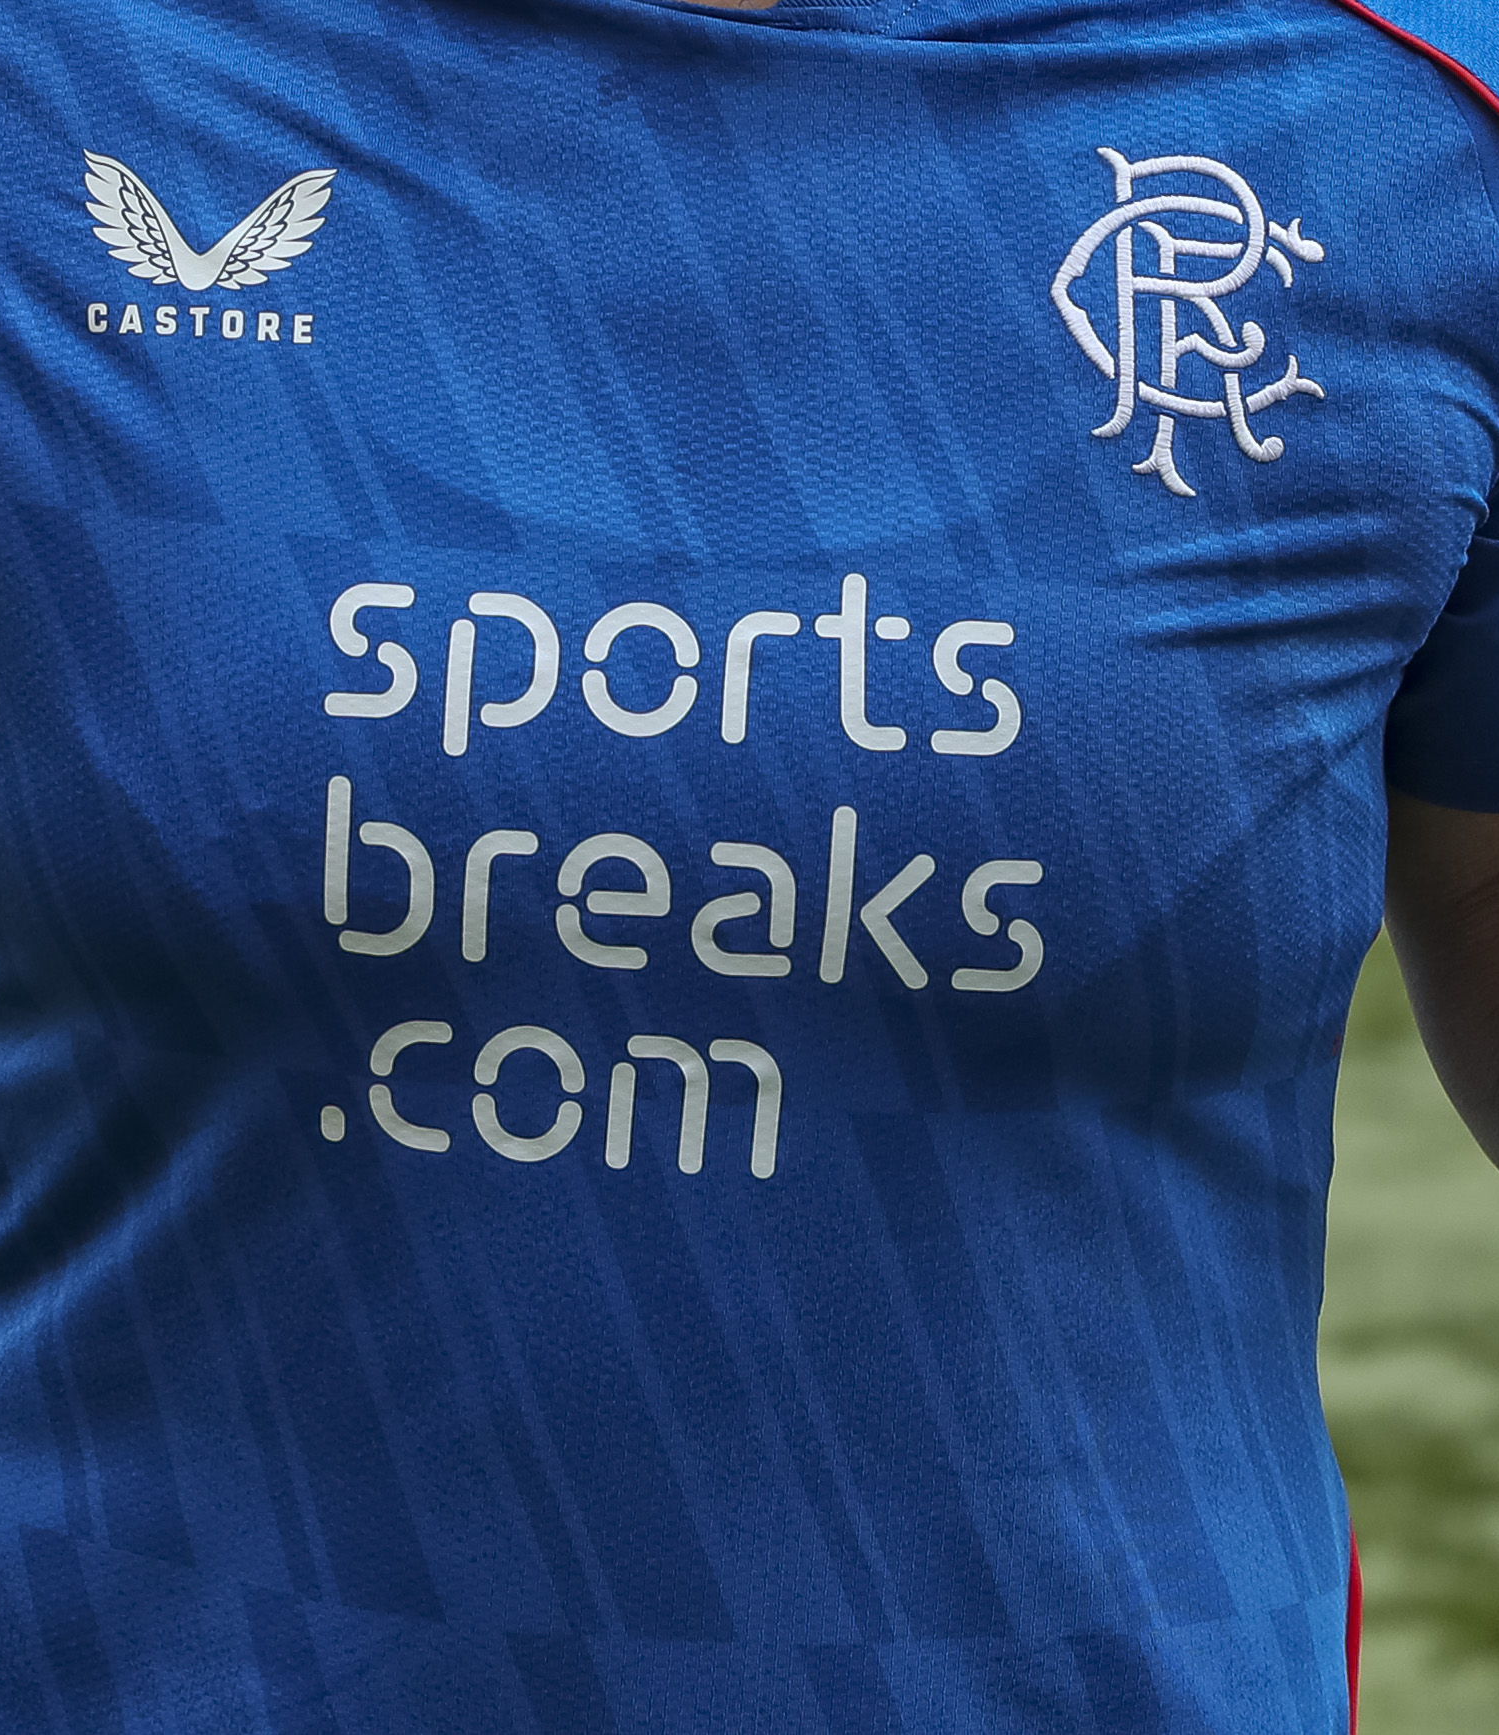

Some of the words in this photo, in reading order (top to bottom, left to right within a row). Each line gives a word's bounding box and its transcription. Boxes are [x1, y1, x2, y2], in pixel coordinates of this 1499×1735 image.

[86, 301, 315, 345] CASTORE
[325, 573, 1021, 756] sports
[325, 776, 1043, 991] breaks
[321, 1021, 781, 1178] .com
